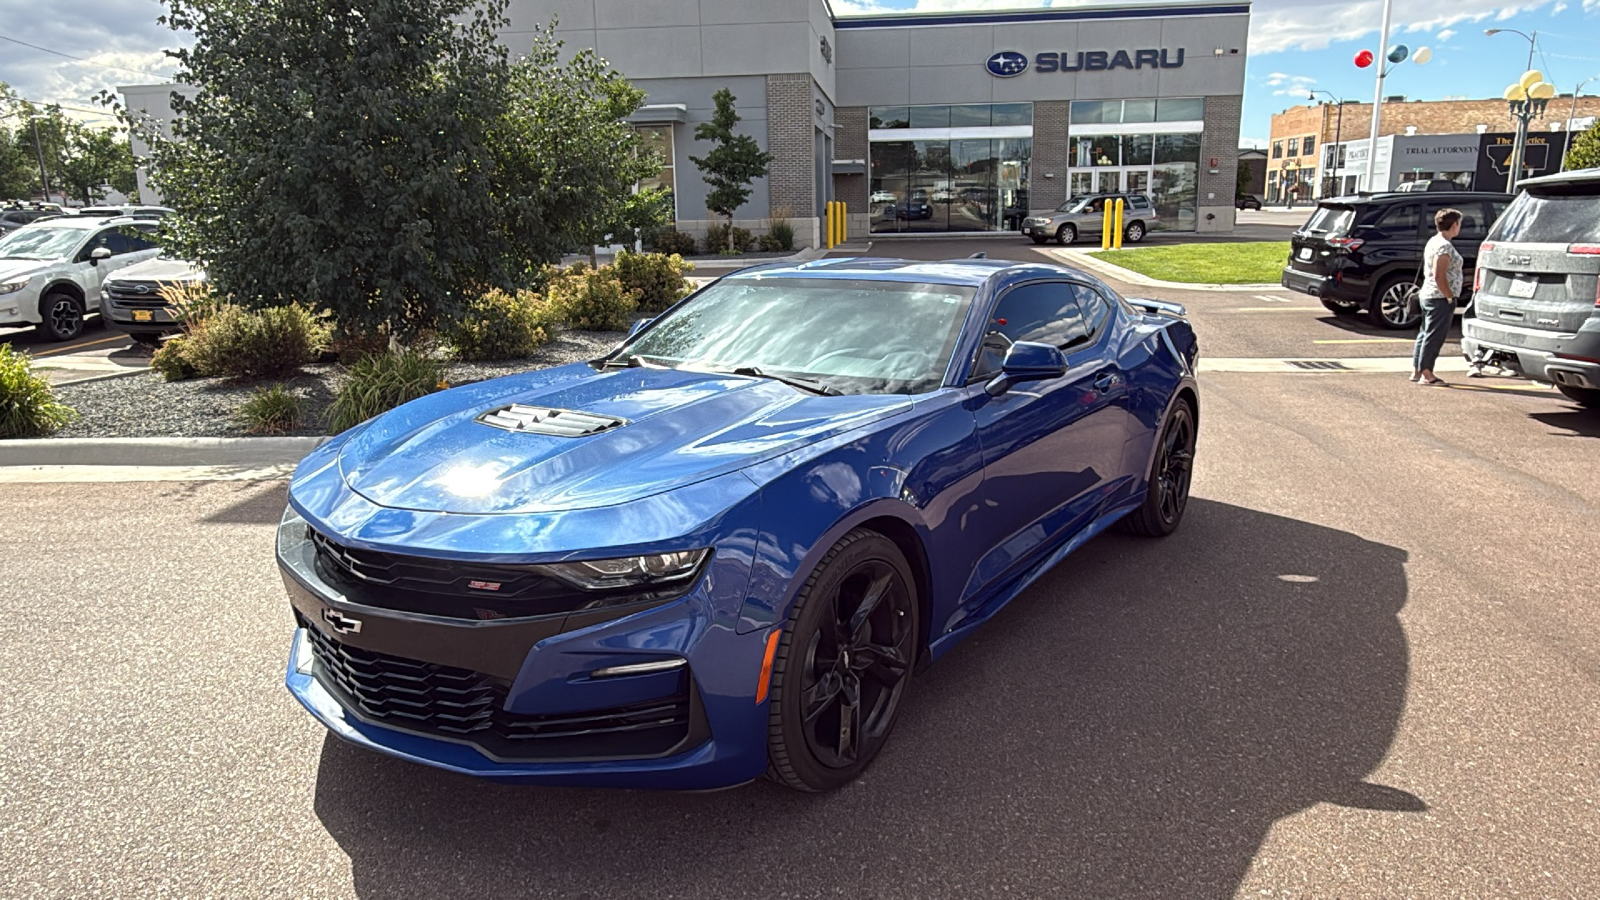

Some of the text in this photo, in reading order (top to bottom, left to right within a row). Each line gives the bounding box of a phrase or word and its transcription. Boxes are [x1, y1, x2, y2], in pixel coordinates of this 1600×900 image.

[1035, 48, 1185, 73] SUBARU
[1496, 137, 1511, 145] The
[1432, 146, 1479, 154] ATTORNEYS
